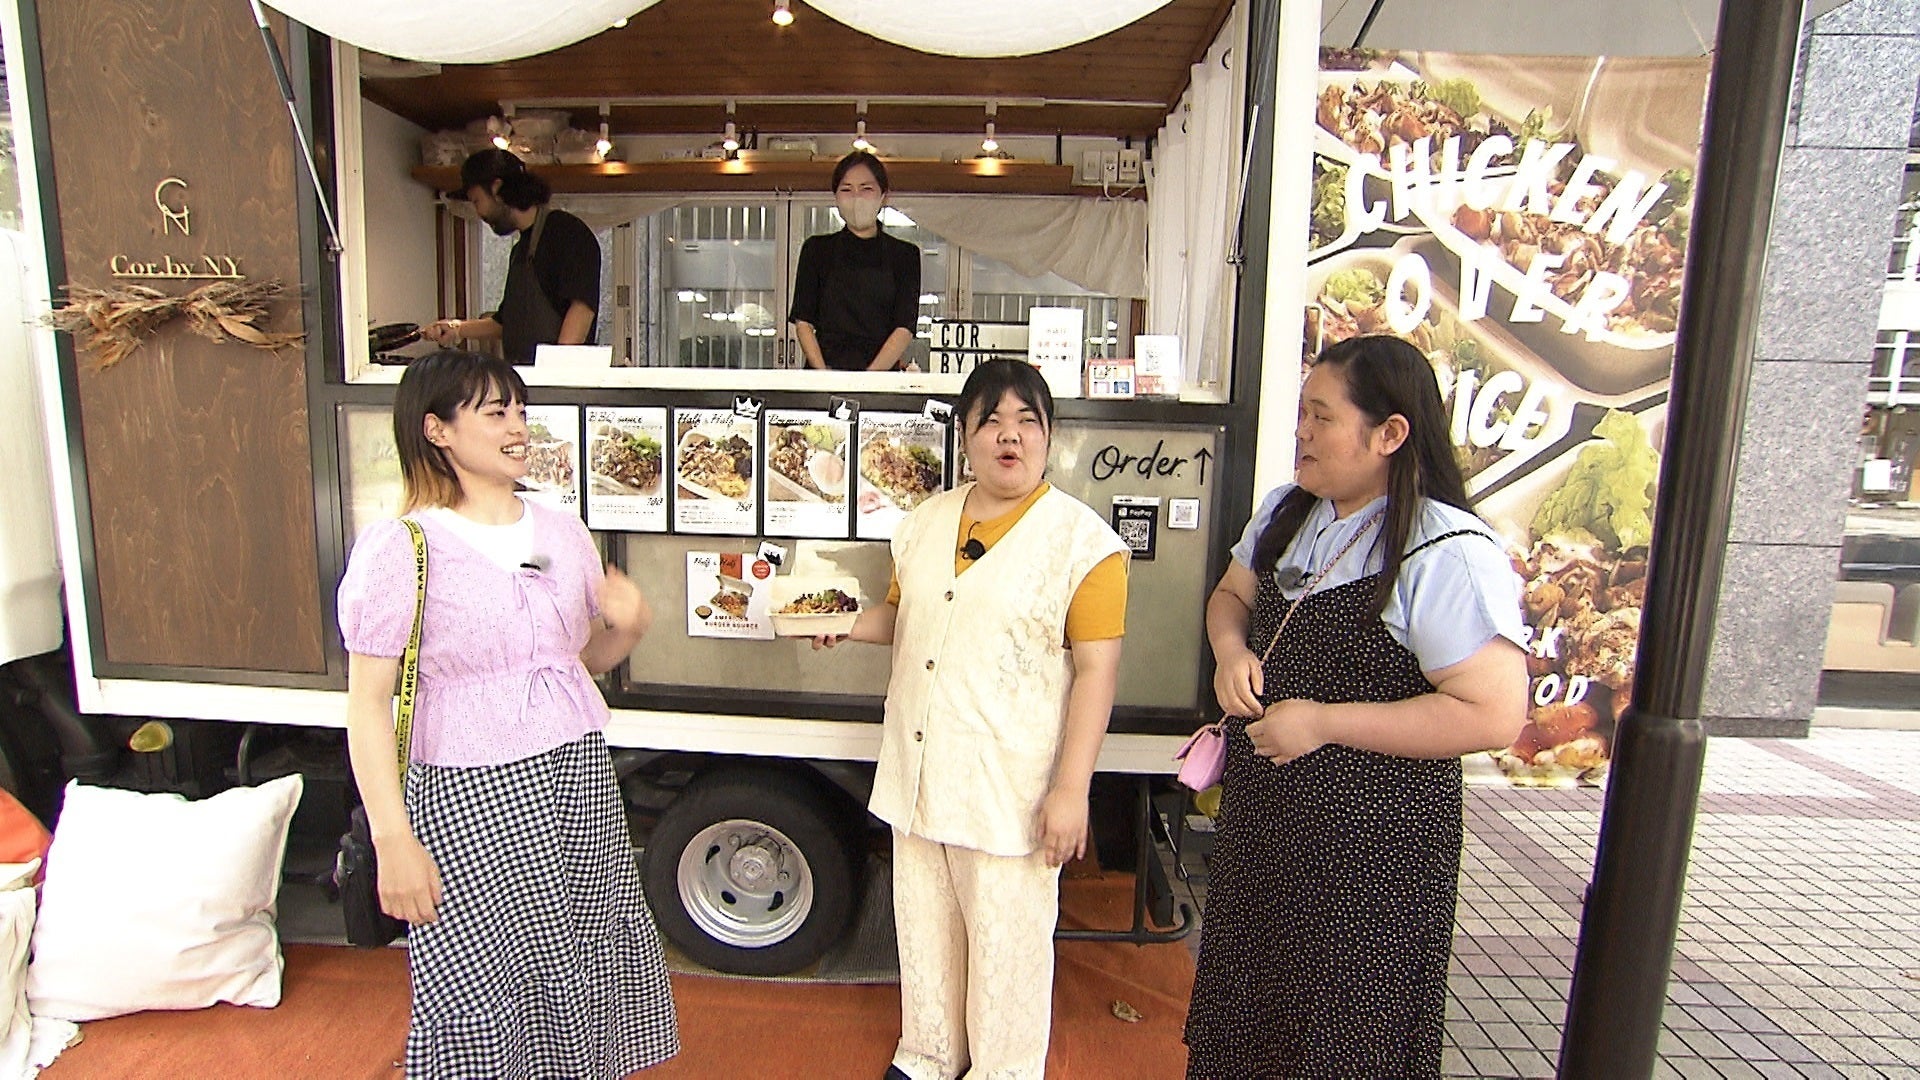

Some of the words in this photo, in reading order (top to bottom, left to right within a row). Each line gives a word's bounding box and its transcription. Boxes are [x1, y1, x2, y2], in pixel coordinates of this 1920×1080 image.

[1345, 135, 1671, 245] CHICKEN
[202, 255, 243, 277] NY
[1385, 248, 1631, 342] OVER
[941, 353, 965, 374] BY
[1442, 366, 1567, 451] ICE
[1129, 509, 1152, 518] PayPay
[1521, 624, 1564, 659] RK
[1534, 673, 1589, 707] OD
